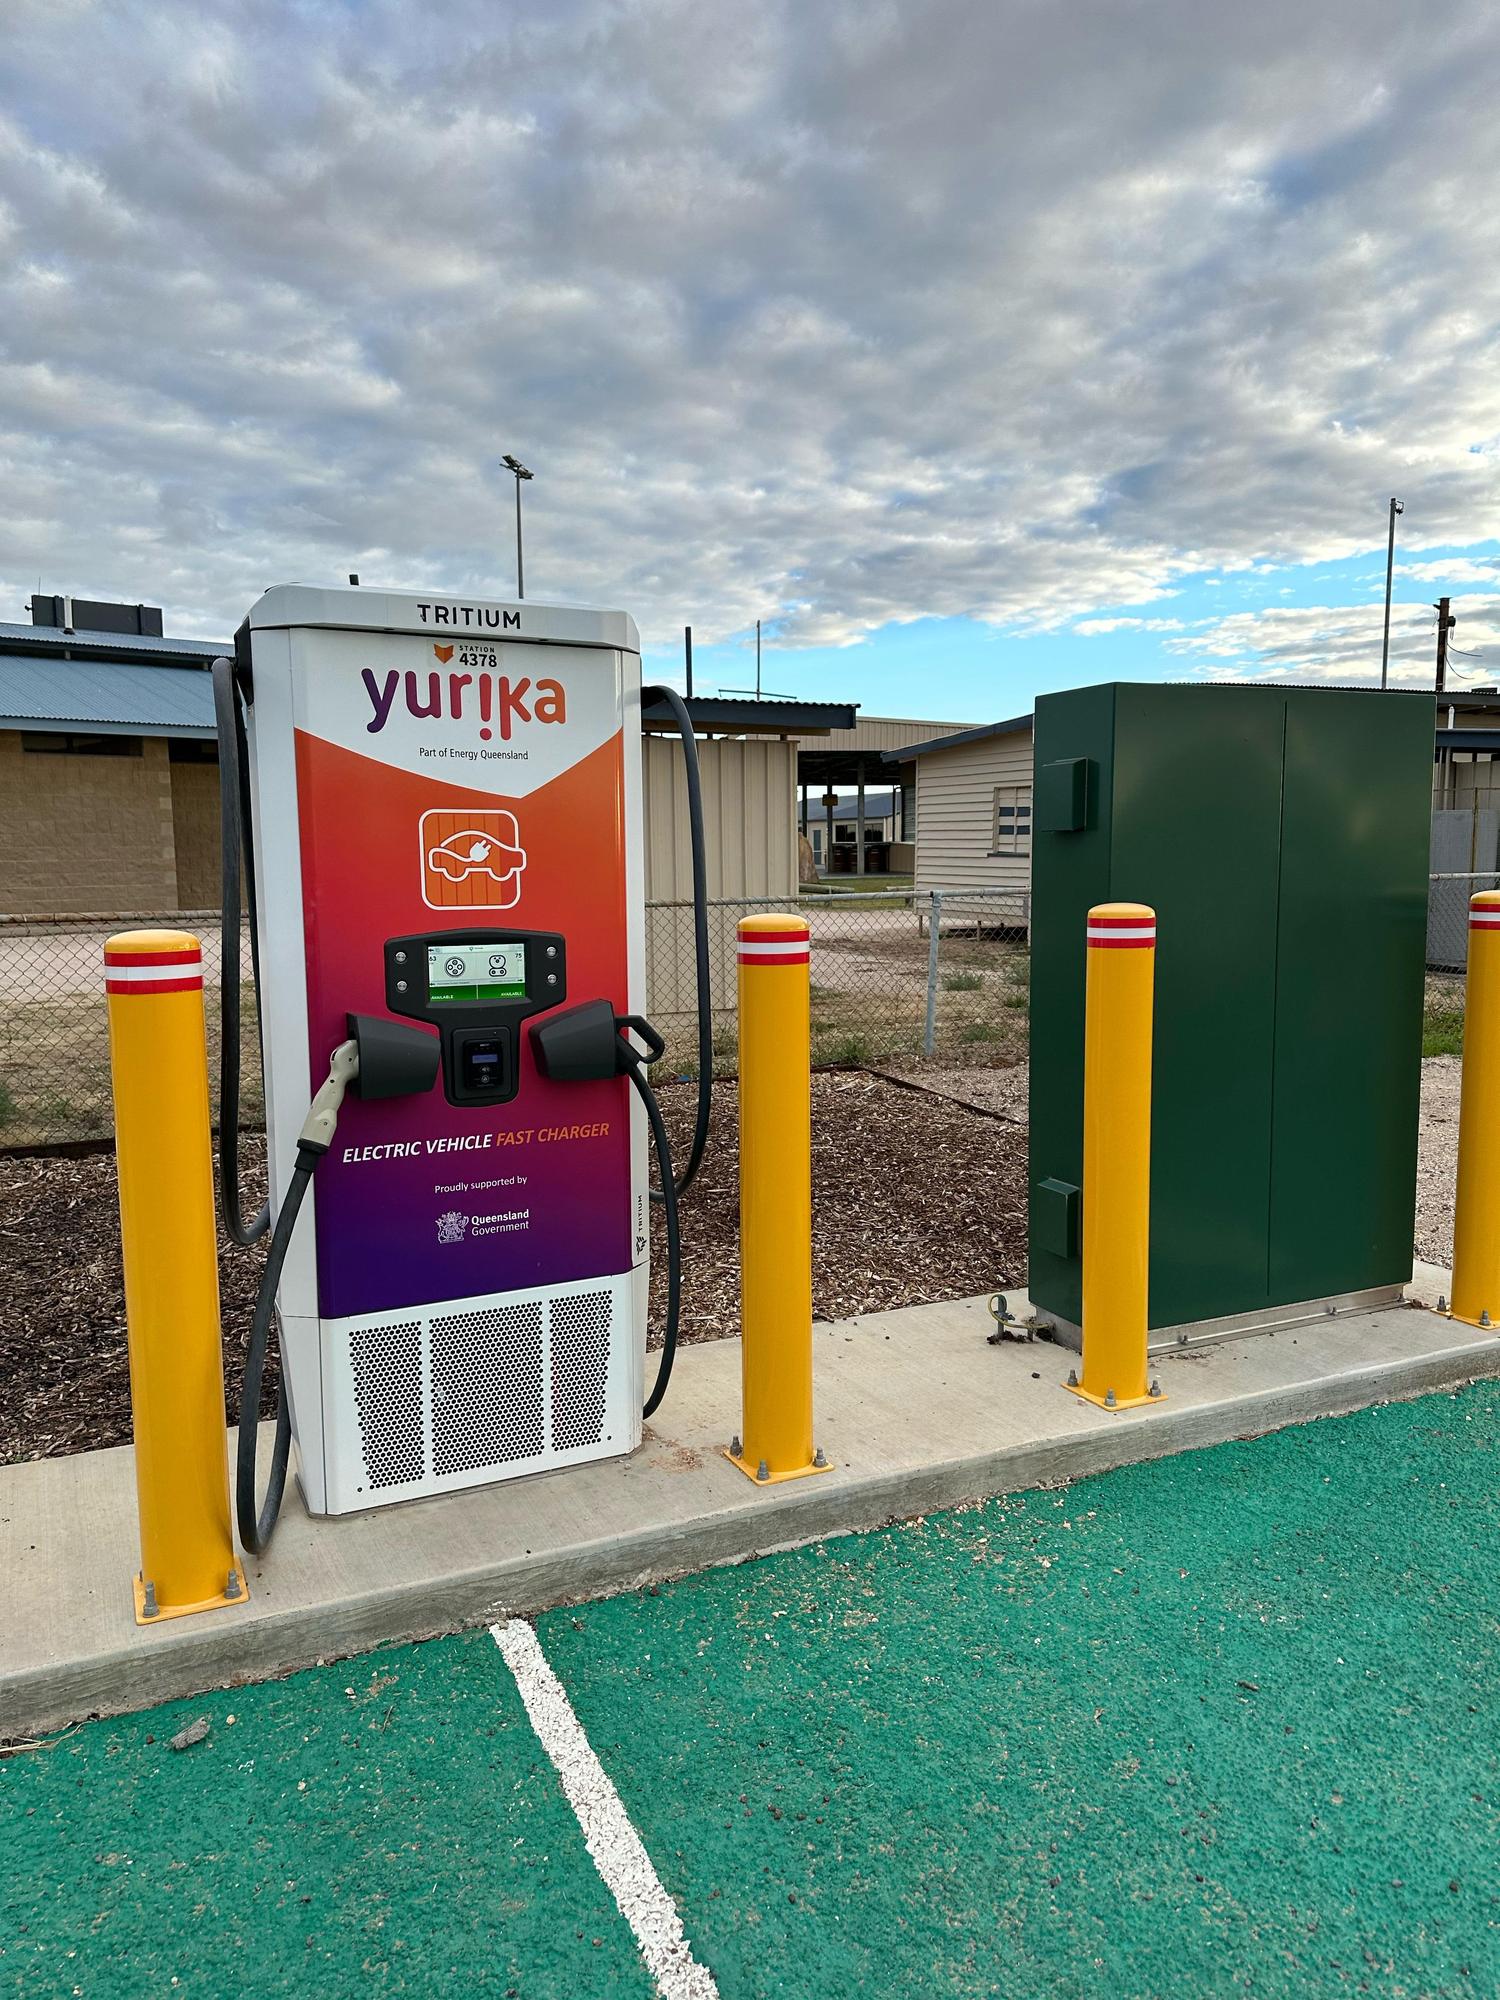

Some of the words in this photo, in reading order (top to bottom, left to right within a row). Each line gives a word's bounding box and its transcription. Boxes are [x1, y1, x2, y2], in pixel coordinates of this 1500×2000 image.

[417, 604, 521, 630] TRITIUM
[459, 645, 495, 653] STATION
[459, 652, 498, 668] 4378
[419, 747, 437, 758] Part
[438, 747, 448, 758] of
[449, 748, 478, 761] Energy
[480, 749, 529, 760] Queensland
[343, 1141, 422, 1163] ELECTRIC
[426, 1134, 493, 1154] VEHICLE
[496, 1130, 535, 1147] FAST
[537, 1122, 610, 1142] CHARGER
[434, 1182, 469, 1194] Proudly
[470, 1175, 515, 1190] supported
[516, 1175, 528, 1185] by
[471, 1208, 530, 1225] Queensland
[471, 1221, 530, 1236] Government
